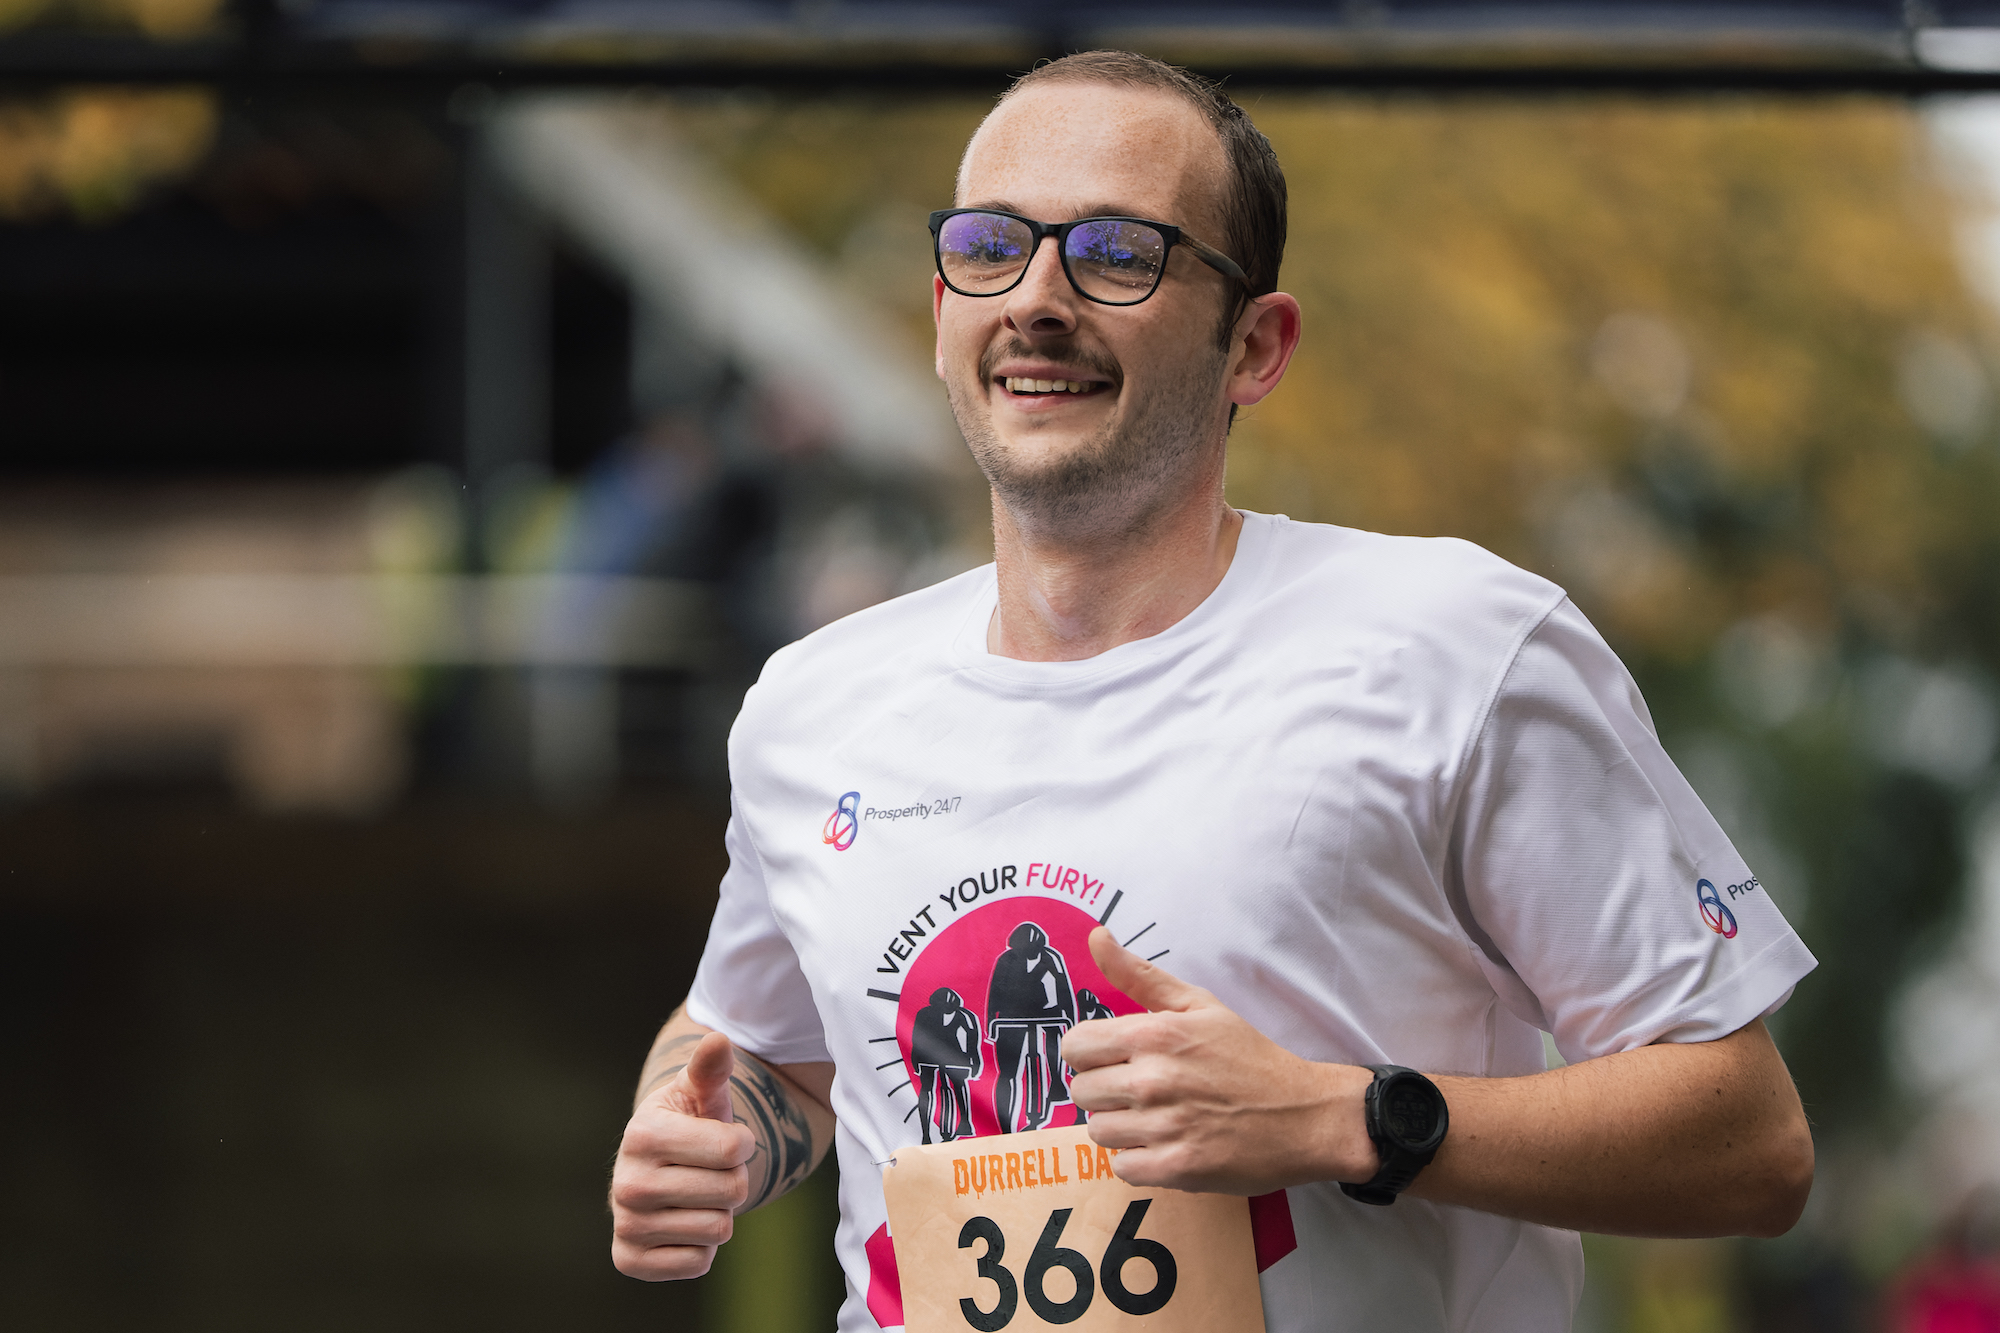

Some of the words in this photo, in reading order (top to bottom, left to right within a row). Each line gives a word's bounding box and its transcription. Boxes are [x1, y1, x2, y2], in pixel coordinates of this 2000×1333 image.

[864, 803, 932, 821] Prosperity
[933, 796, 961, 815] 24/7
[877, 904, 936, 974] VENT
[939, 865, 1017, 911] YOUR
[1026, 862, 1104, 905] FURY!
[952, 1146, 1068, 1199] DURRELL
[1075, 1144, 1124, 1183] DA
[958, 1198, 1177, 1333] 366
